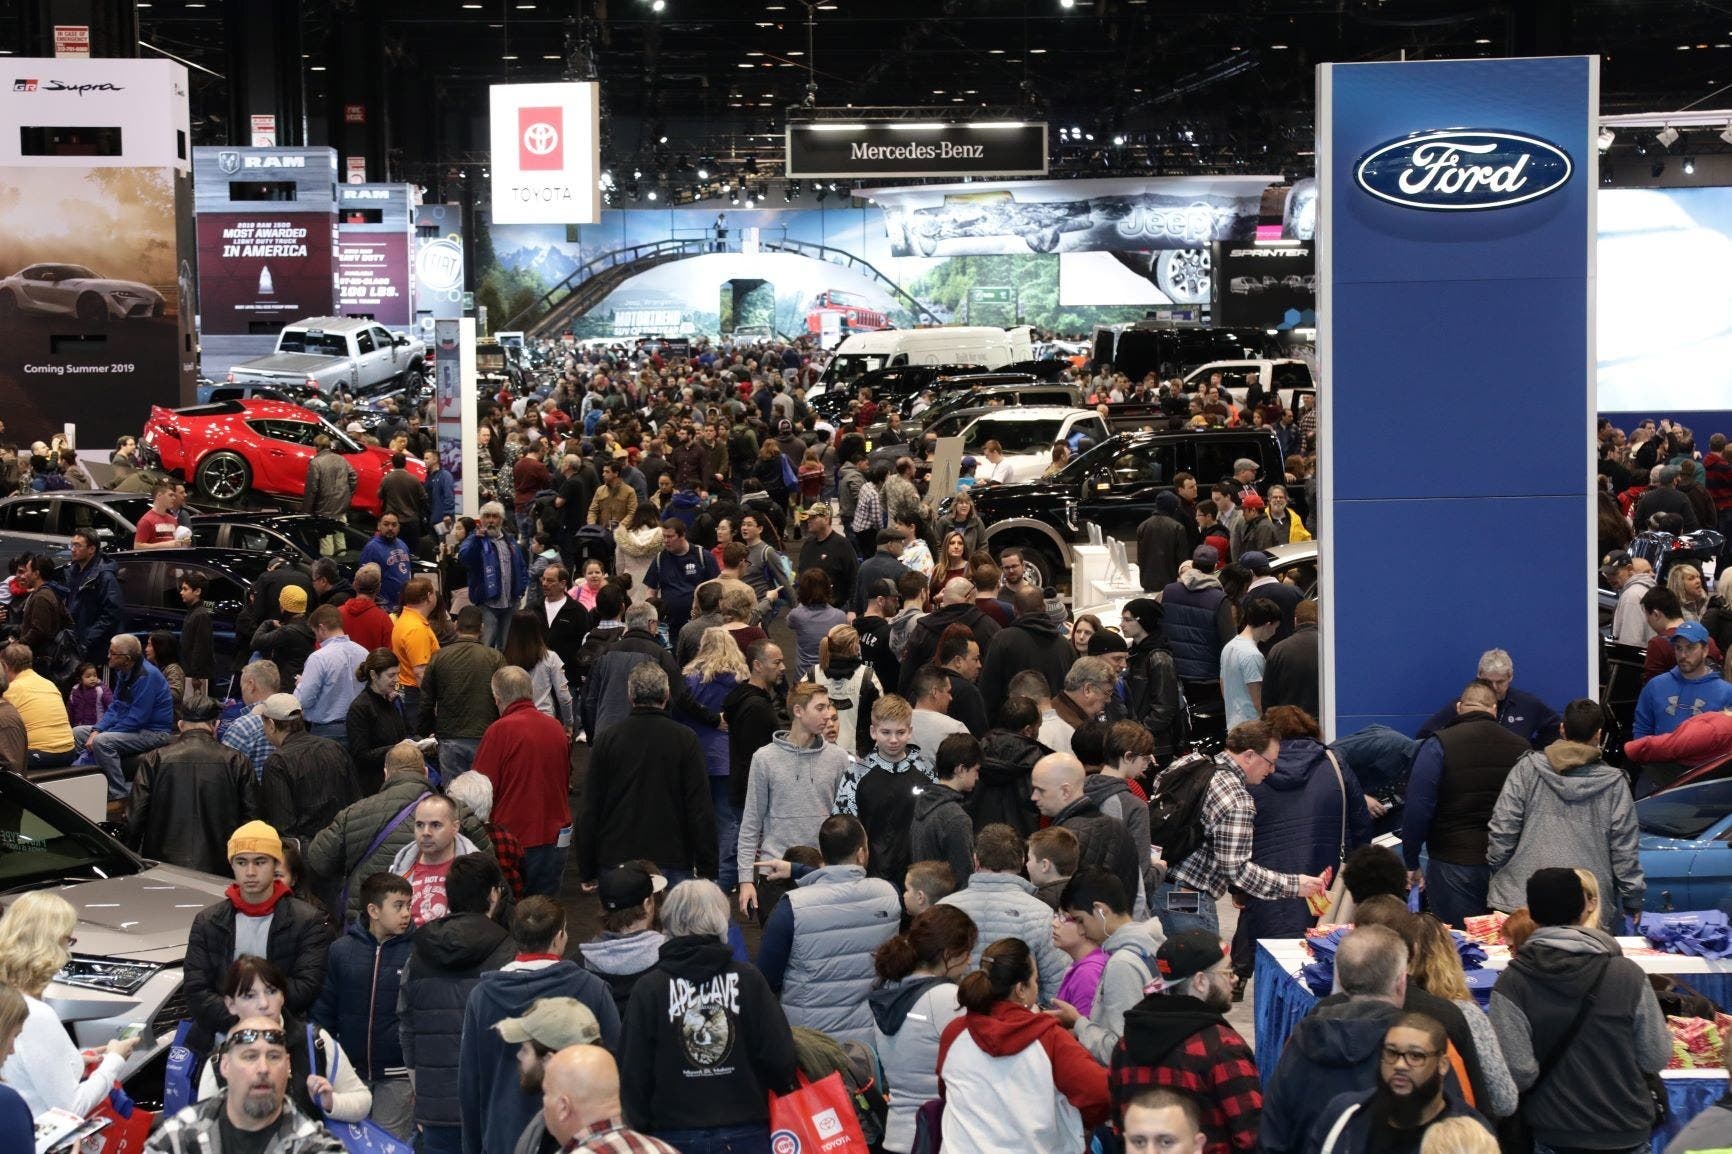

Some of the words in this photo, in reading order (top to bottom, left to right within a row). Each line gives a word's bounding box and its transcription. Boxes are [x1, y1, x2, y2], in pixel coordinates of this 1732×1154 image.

[42, 80, 125, 97] Supra
[851, 141, 984, 160] Mercedes-Benz
[244, 156, 305, 168] RAM
[1398, 142, 1530, 194] Ford
[344, 190, 390, 199] RAM
[512, 187, 572, 202] TOYOTA
[1118, 206, 1213, 241] Jeep
[223, 228, 254, 238] MOST
[255, 228, 307, 238] AWARDED
[222, 245, 240, 257] IN
[242, 245, 307, 257] AMERICA
[1230, 248, 1309, 257] SPRINTER
[24, 364, 64, 375] Coming
[66, 364, 109, 374] Summer
[111, 363, 135, 373] 2019
[668, 977, 698, 1023] APE
[700, 972, 740, 1015] CAVE
[820, 1135, 852, 1153] TOYOTA
